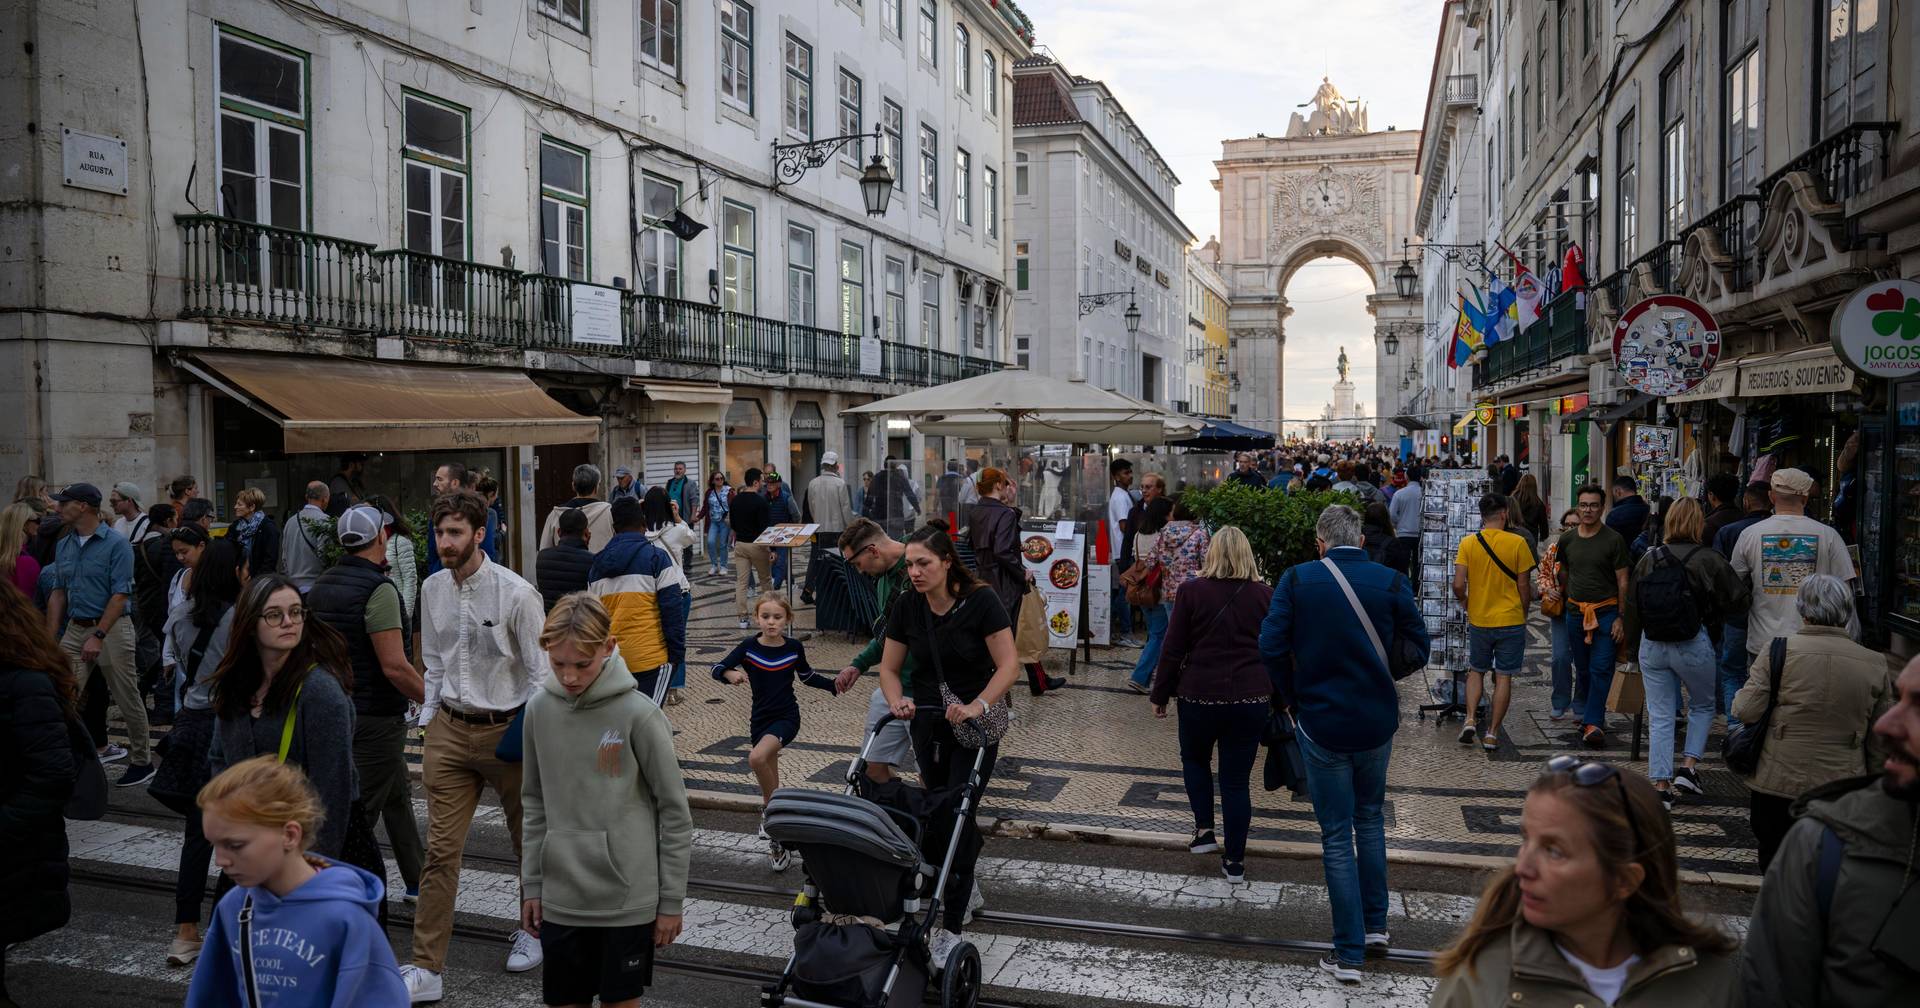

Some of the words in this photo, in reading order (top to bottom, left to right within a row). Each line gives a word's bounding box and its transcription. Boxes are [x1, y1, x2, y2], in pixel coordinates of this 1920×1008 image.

[89, 151, 105, 161] RUA
[80, 163, 114, 176] AUGUSTA
[1864, 345, 1920, 365] JOGOS
[1869, 361, 1920, 369] SANTACASA
[1748, 370, 1788, 390] RECUERDOS
[1796, 364, 1845, 386] SOUVENIRS
[273, 928, 326, 968] TEAM
[254, 958, 284, 971] COOL
[255, 974, 298, 987] MENTS
